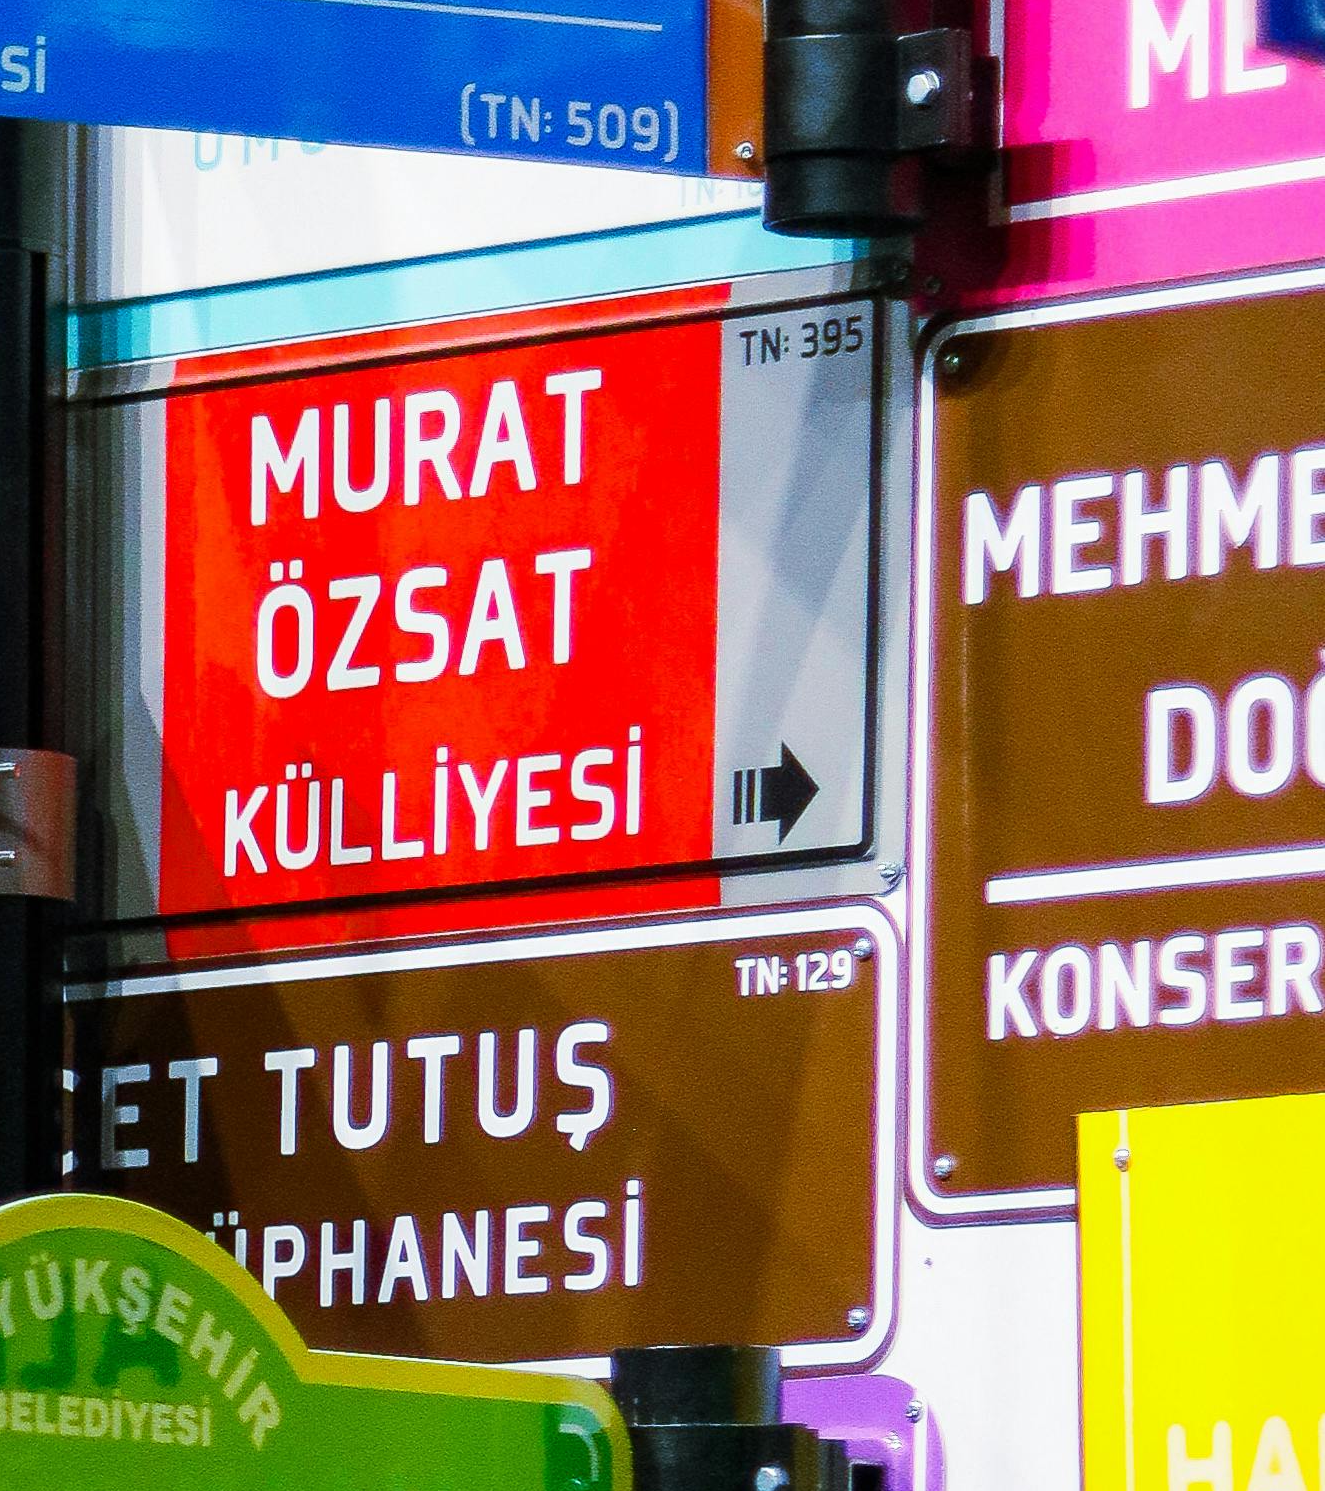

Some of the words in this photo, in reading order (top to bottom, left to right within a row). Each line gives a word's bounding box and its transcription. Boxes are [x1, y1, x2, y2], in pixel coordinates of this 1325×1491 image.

[565, 93, 682, 165] 509)
[738, 327, 790, 369] TN:
[800, 317, 865, 361] 395
[250, 367, 604, 528] MURAT
[255, 546, 594, 700] ÖZSAT
[223, 723, 644, 879] KÜLLİYESİ
[795, 950, 854, 992] 129
[264, 1020, 614, 1152] TUTUŞ
